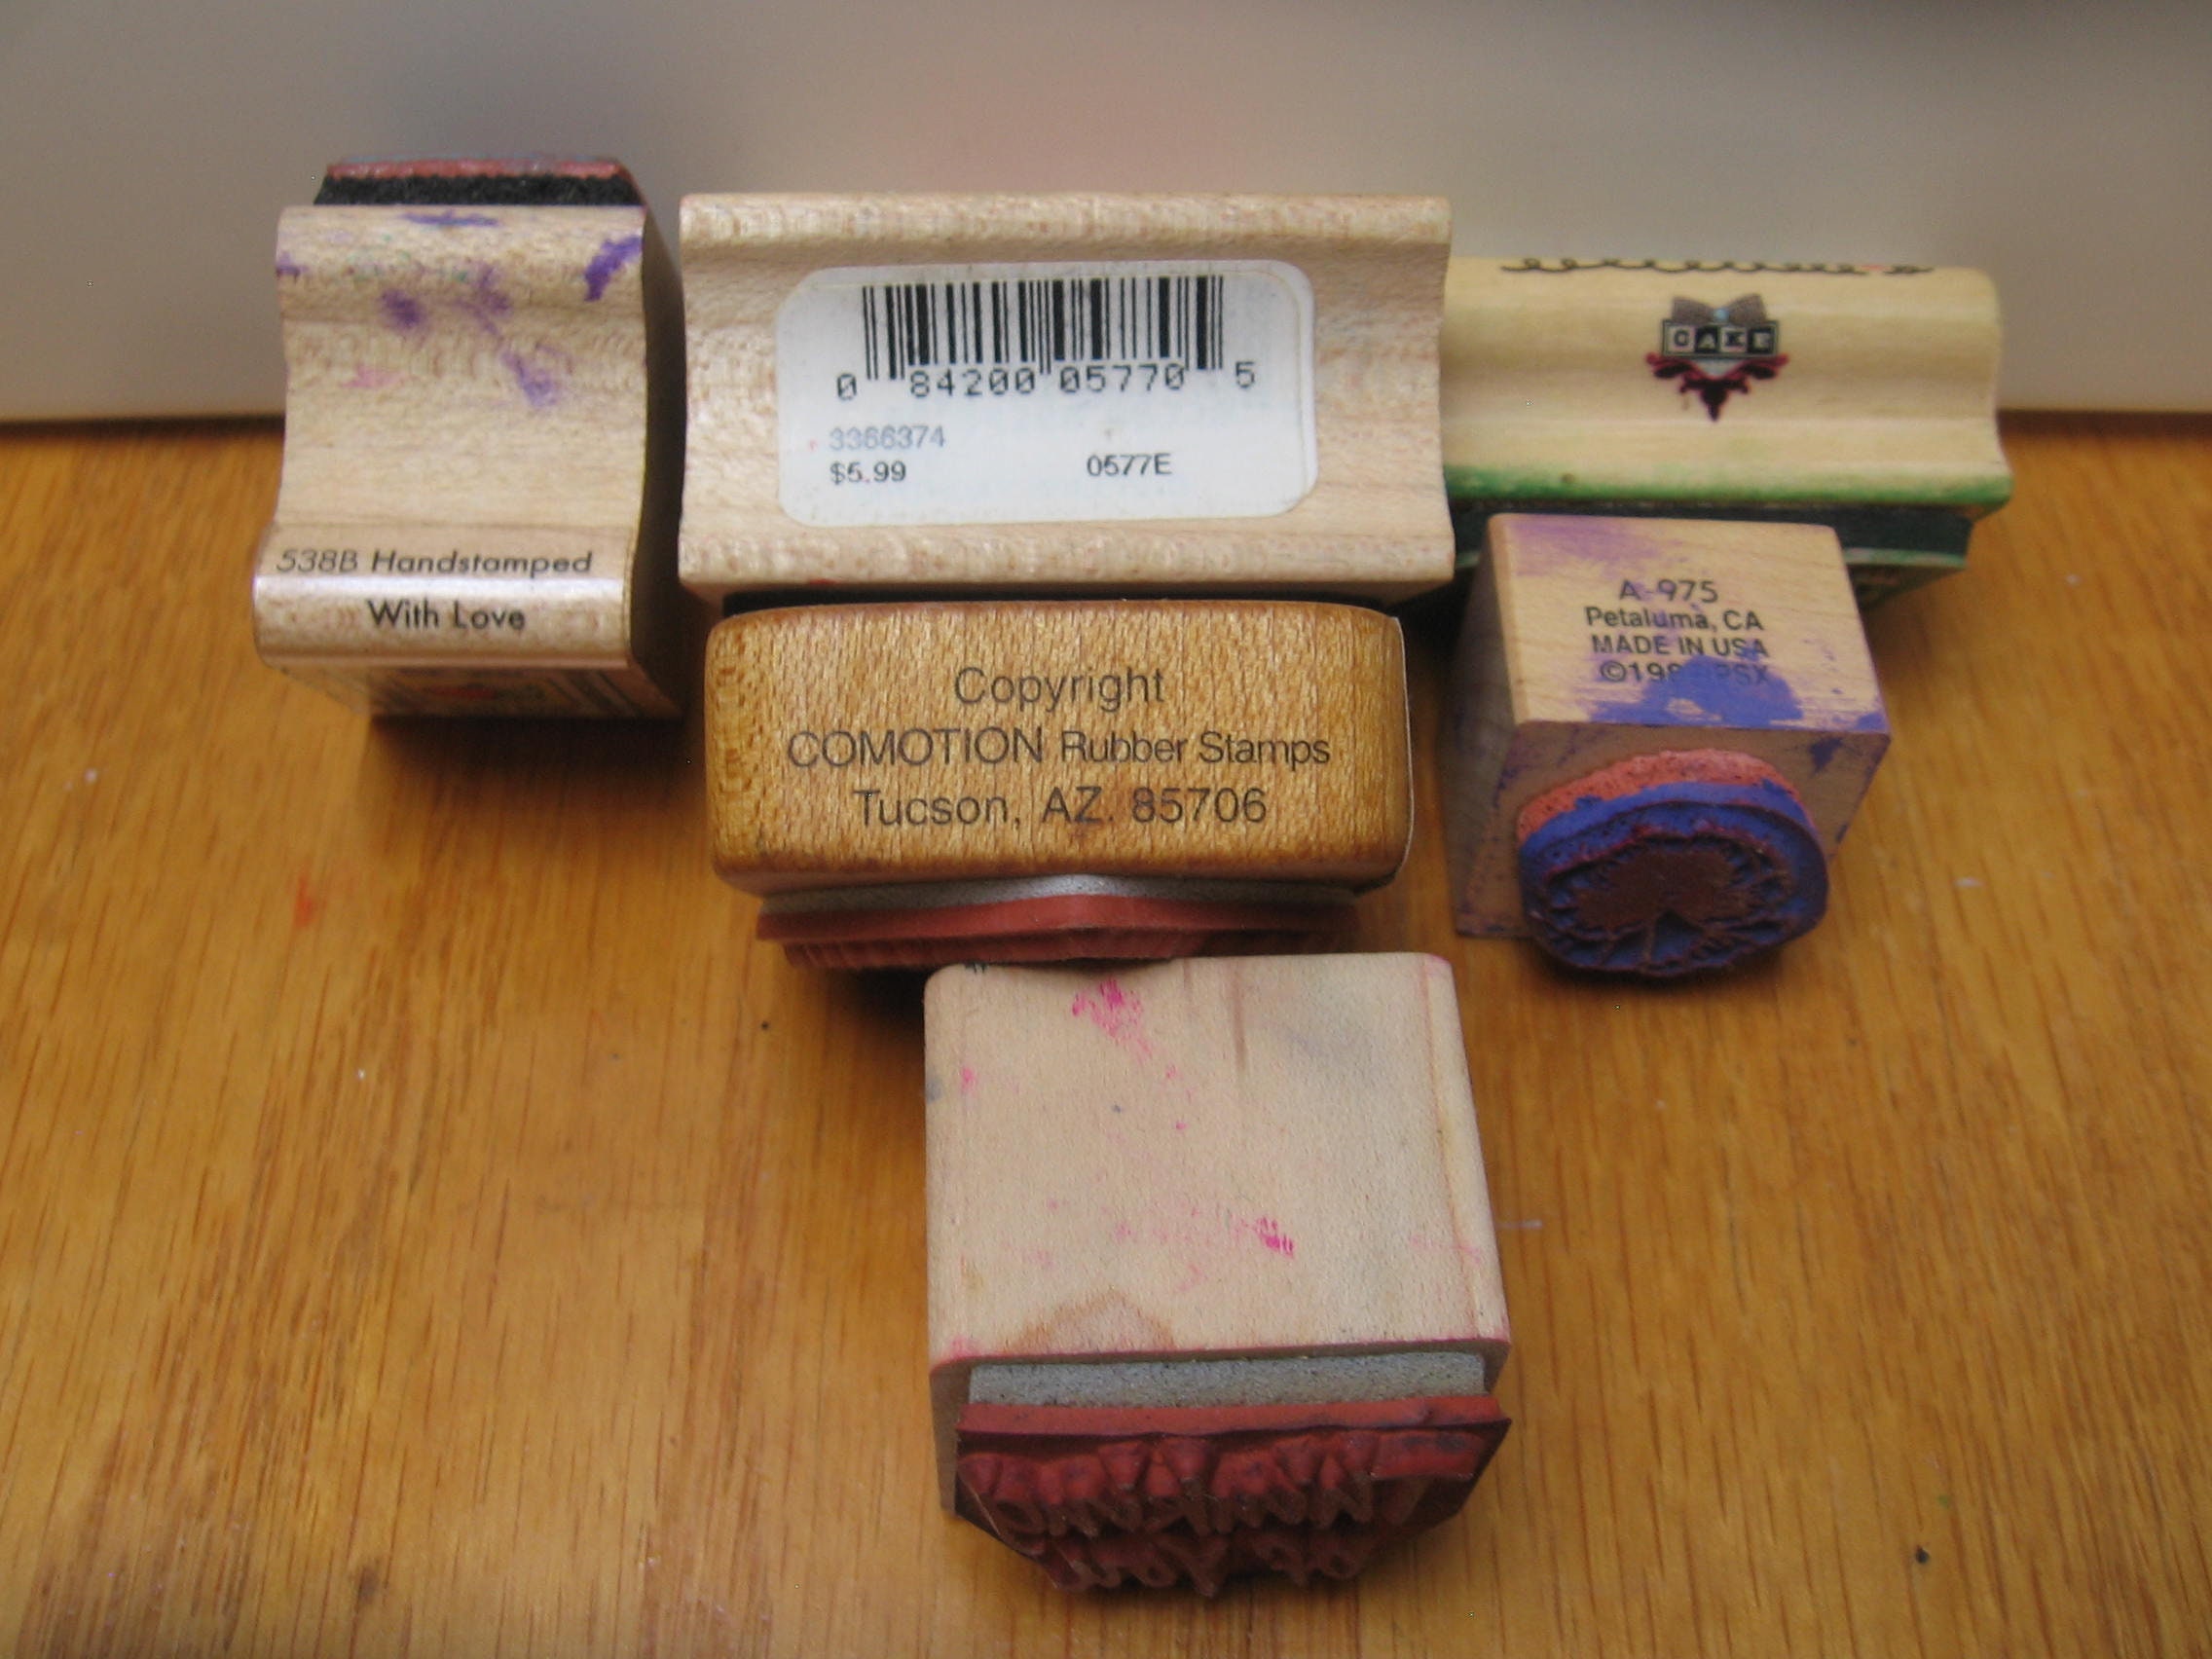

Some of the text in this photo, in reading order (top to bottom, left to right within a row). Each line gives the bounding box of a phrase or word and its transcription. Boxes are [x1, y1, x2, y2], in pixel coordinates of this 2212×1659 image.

[836, 361, 1256, 400] 0 84200 05770 5
[830, 461, 906, 485] $5.99
[1087, 453, 1172, 478] 0577E
[276, 549, 594, 577] 538B Handstamped
[367, 600, 526, 631] With Love
[1585, 607, 1764, 632] Petaluma, CA
[1592, 635, 1769, 658] MADE IN USA
[954, 667, 1165, 712] Copyright
[788, 726, 1330, 770] COMOTION Rubber Stamps
[854, 787, 1021, 829] Tucson,
[1131, 787, 1267, 824] 85706
